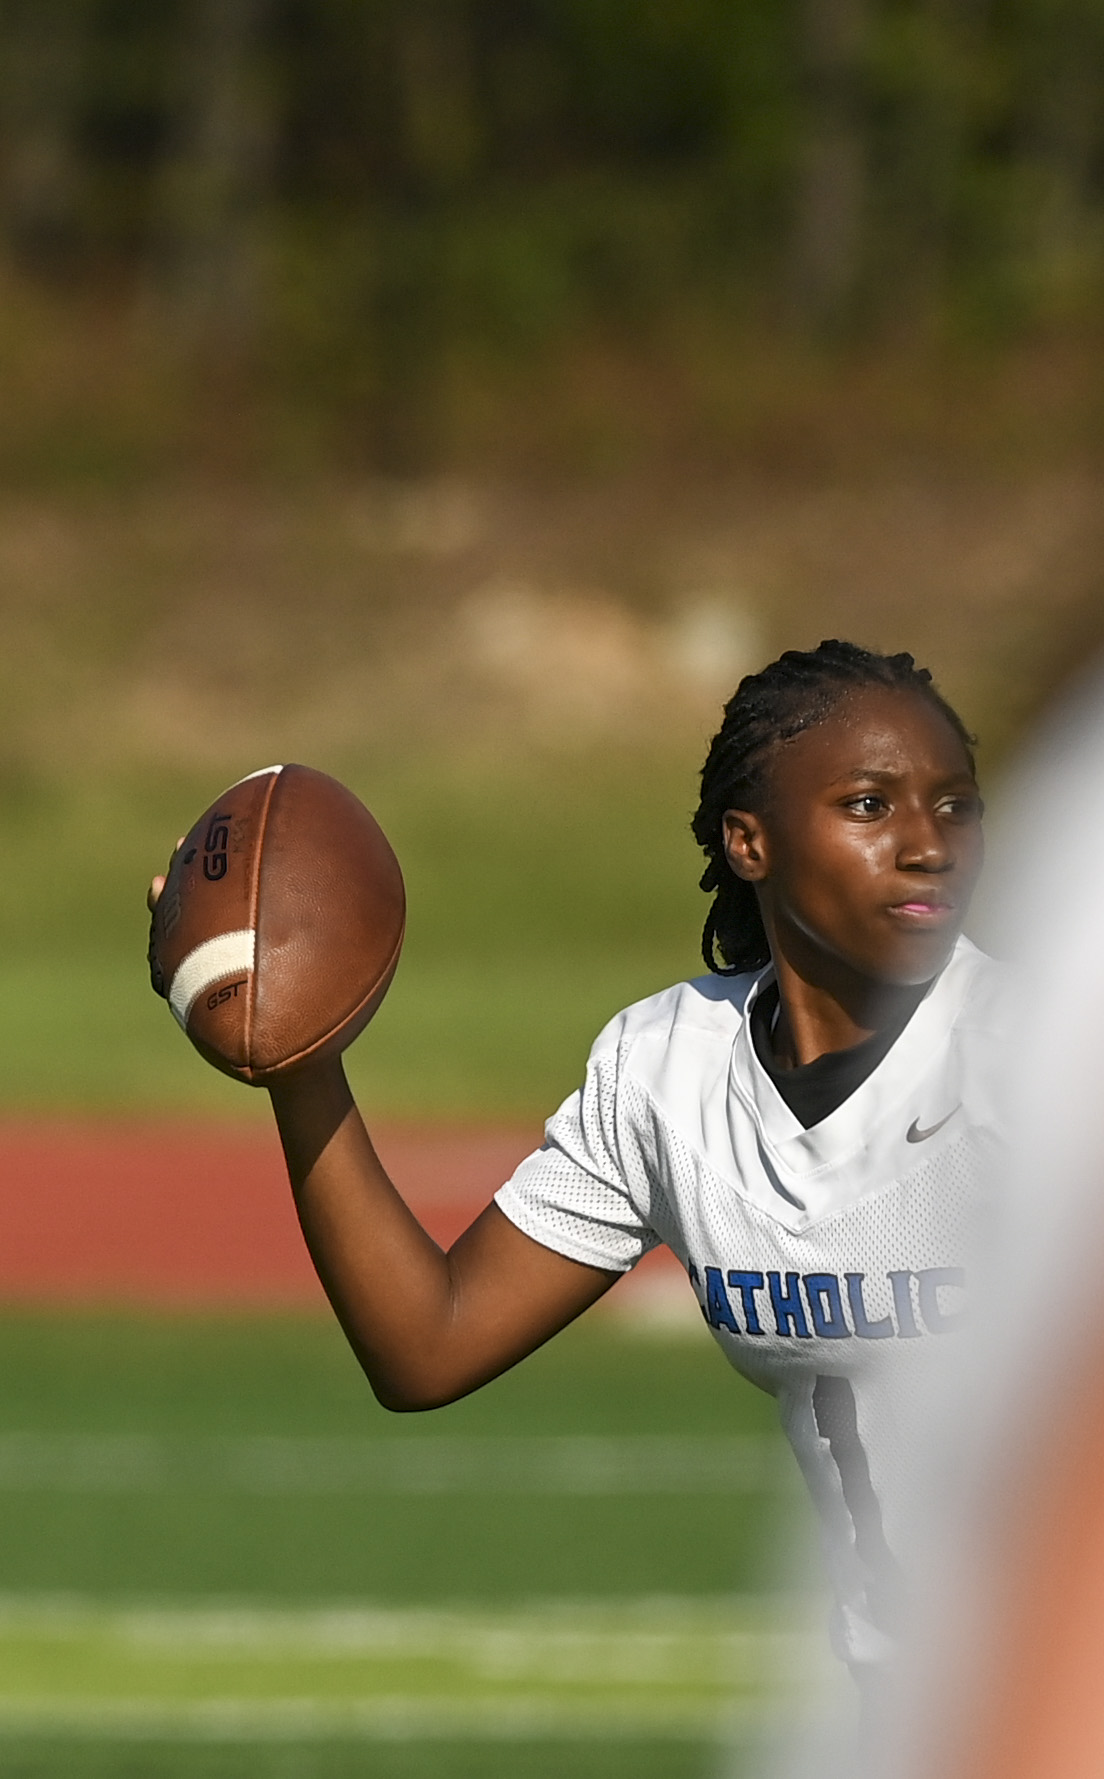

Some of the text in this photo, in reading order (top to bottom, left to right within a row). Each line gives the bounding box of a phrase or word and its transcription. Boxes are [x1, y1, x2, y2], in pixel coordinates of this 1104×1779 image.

[203, 813, 232, 881] GST
[207, 979, 248, 1010] GST
[688, 1258, 966, 1340] ATHOLIC
